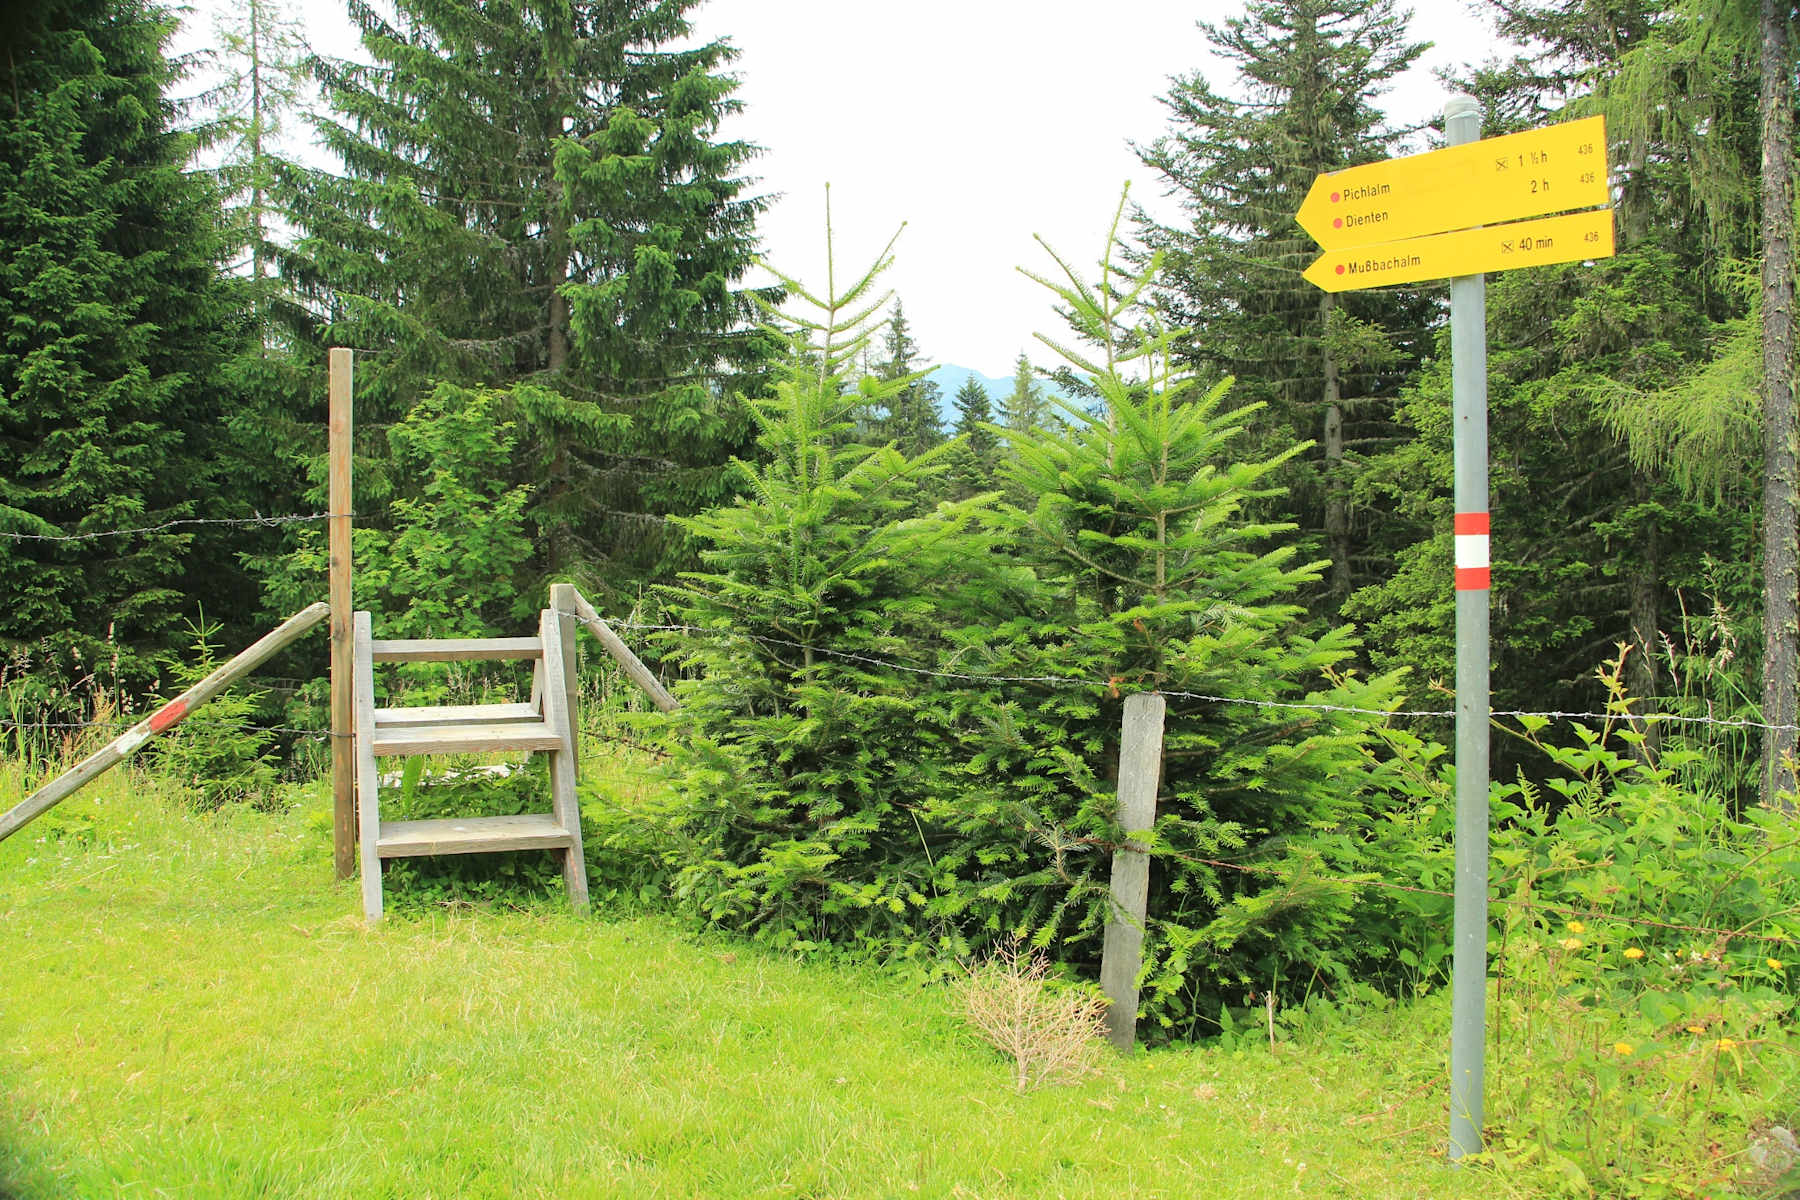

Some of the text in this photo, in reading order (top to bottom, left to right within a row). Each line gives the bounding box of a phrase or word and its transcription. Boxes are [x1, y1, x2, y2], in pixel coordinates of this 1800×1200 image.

[1517, 153, 1524, 168] 1
[1540, 149, 1548, 163] h
[1343, 183, 1391, 201] Pichlalm
[1530, 177, 1550, 193] 2 h
[1345, 210, 1389, 228] Dienten
[1518, 236, 1553, 251] 40 min
[1348, 254, 1421, 275] Mußbachalm
